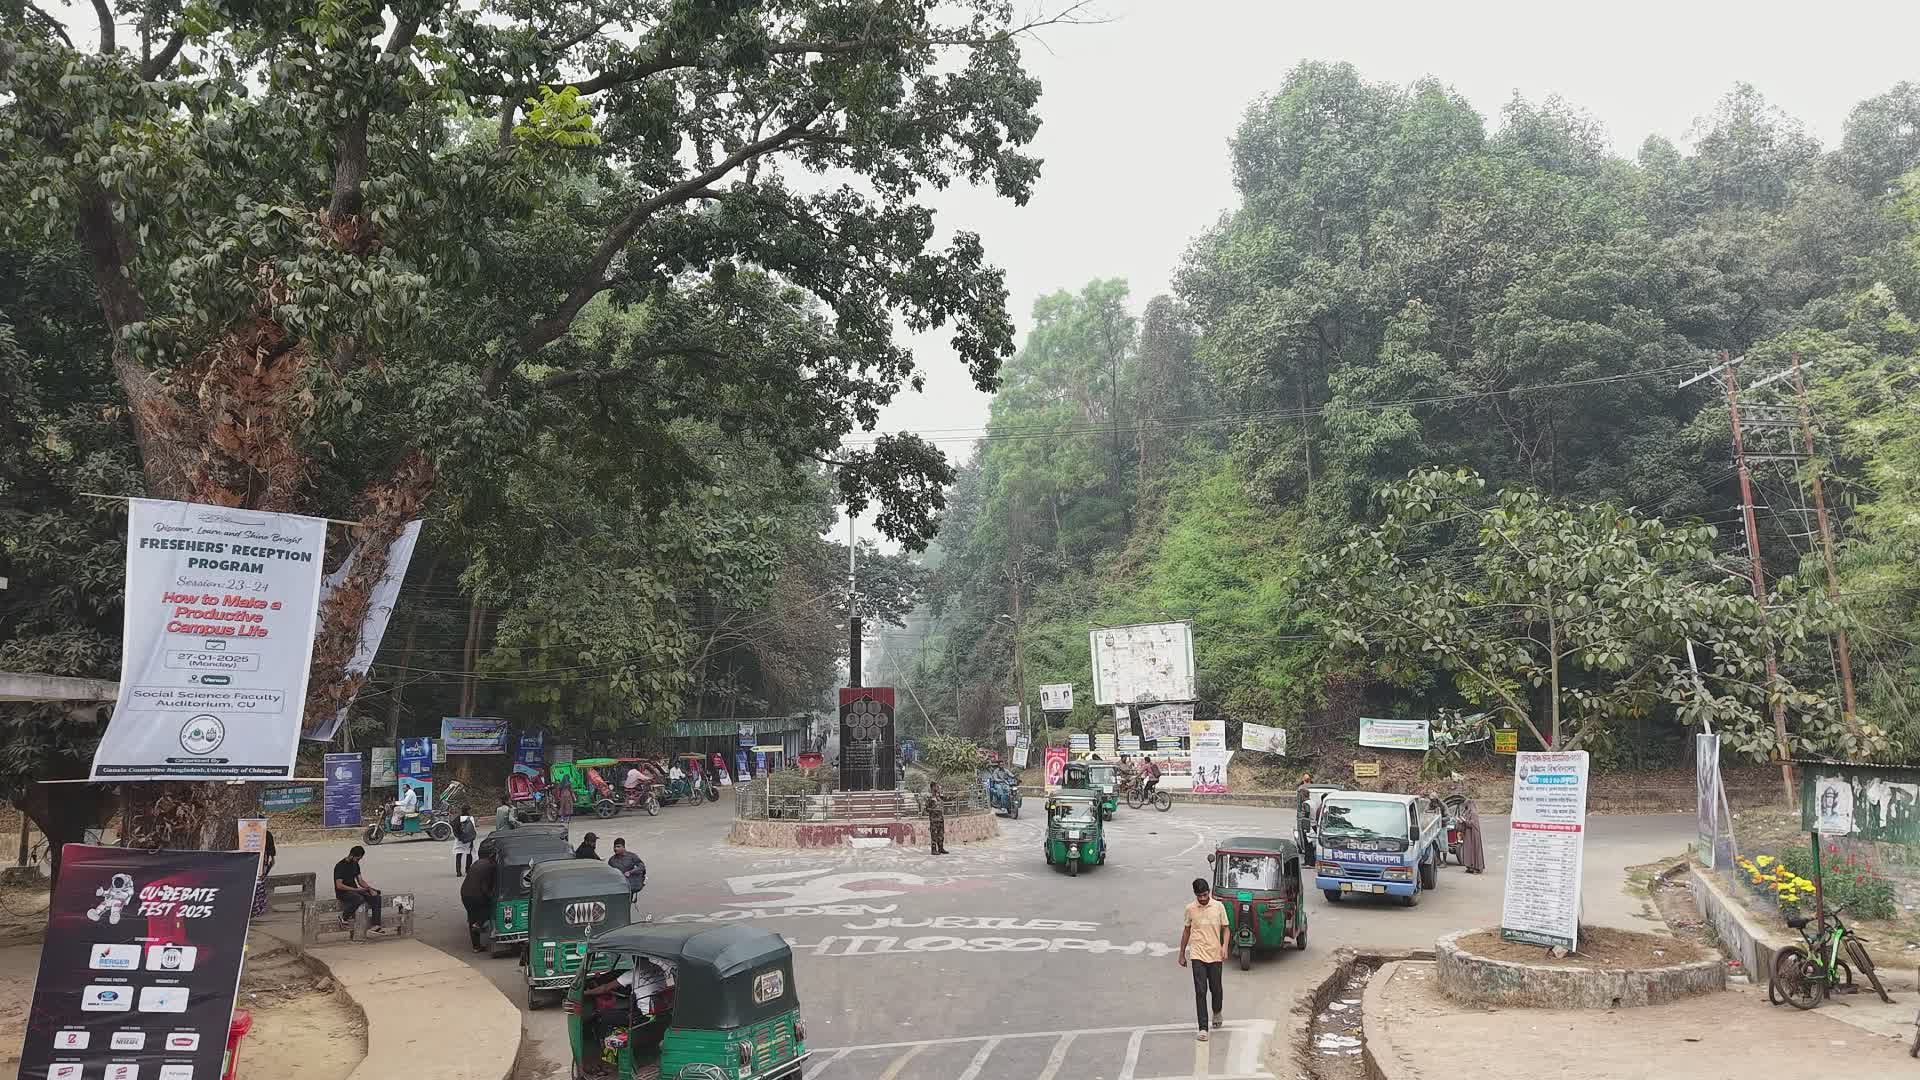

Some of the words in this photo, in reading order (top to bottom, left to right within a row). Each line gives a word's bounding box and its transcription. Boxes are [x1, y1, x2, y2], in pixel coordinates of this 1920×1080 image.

[196, 526, 221, 536] Learn
[223, 529, 241, 537] and
[243, 530, 268, 540] Shine
[231, 544, 312, 562] RECEPTION
[188, 557, 264, 574] PROGRAM
[161, 591, 200, 604] How
[201, 594, 220, 606] to
[221, 594, 268, 609] Make
[270, 601, 282, 610] a
[174, 606, 264, 623] Productive
[166, 620, 235, 636] Campus
[238, 624, 269, 638] Life
[177, 653, 249, 663] 27-01-2025
[189, 660, 237, 669] (Monday)
[134, 690, 174, 698] Social
[178, 691, 231, 699] Science
[234, 692, 281, 702] Faculty
[1347, 841, 1378, 850] ISUZU
[137, 901, 176, 916] FEST
[176, 905, 214, 918] 2025
[662, 903, 898, 923] GOLDEN
[841, 916, 1102, 931] JUBILEE
